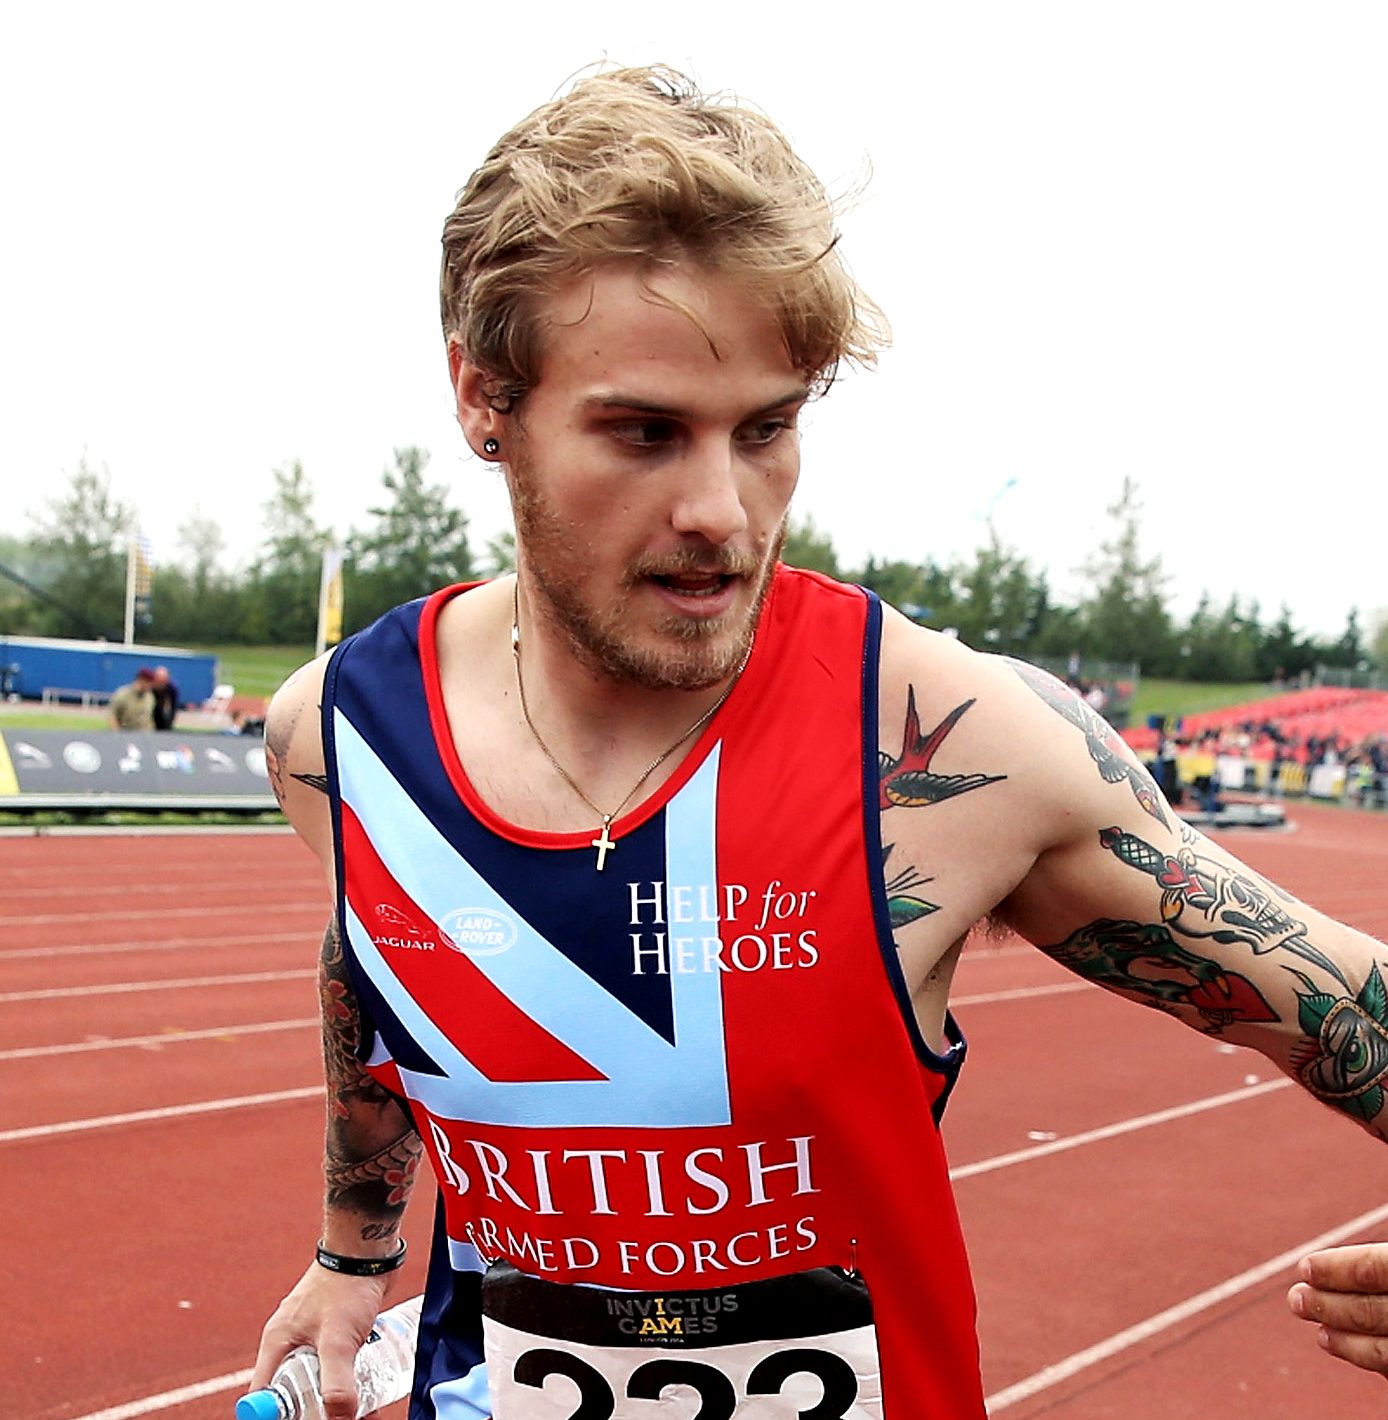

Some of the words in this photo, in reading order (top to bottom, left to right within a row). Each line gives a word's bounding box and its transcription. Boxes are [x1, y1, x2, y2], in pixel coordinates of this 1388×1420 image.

[628, 881, 748, 926] HELP
[755, 880, 817, 930] for
[372, 935, 435, 952] JAGUAR
[631, 930, 820, 976] HEROES
[427, 1115, 822, 1218] BRITISH
[466, 1216, 600, 1272] RMED
[619, 1216, 818, 1276] FORCES
[606, 1293, 739, 1317] INVICTUS
[617, 1315, 719, 1336] GAMES
